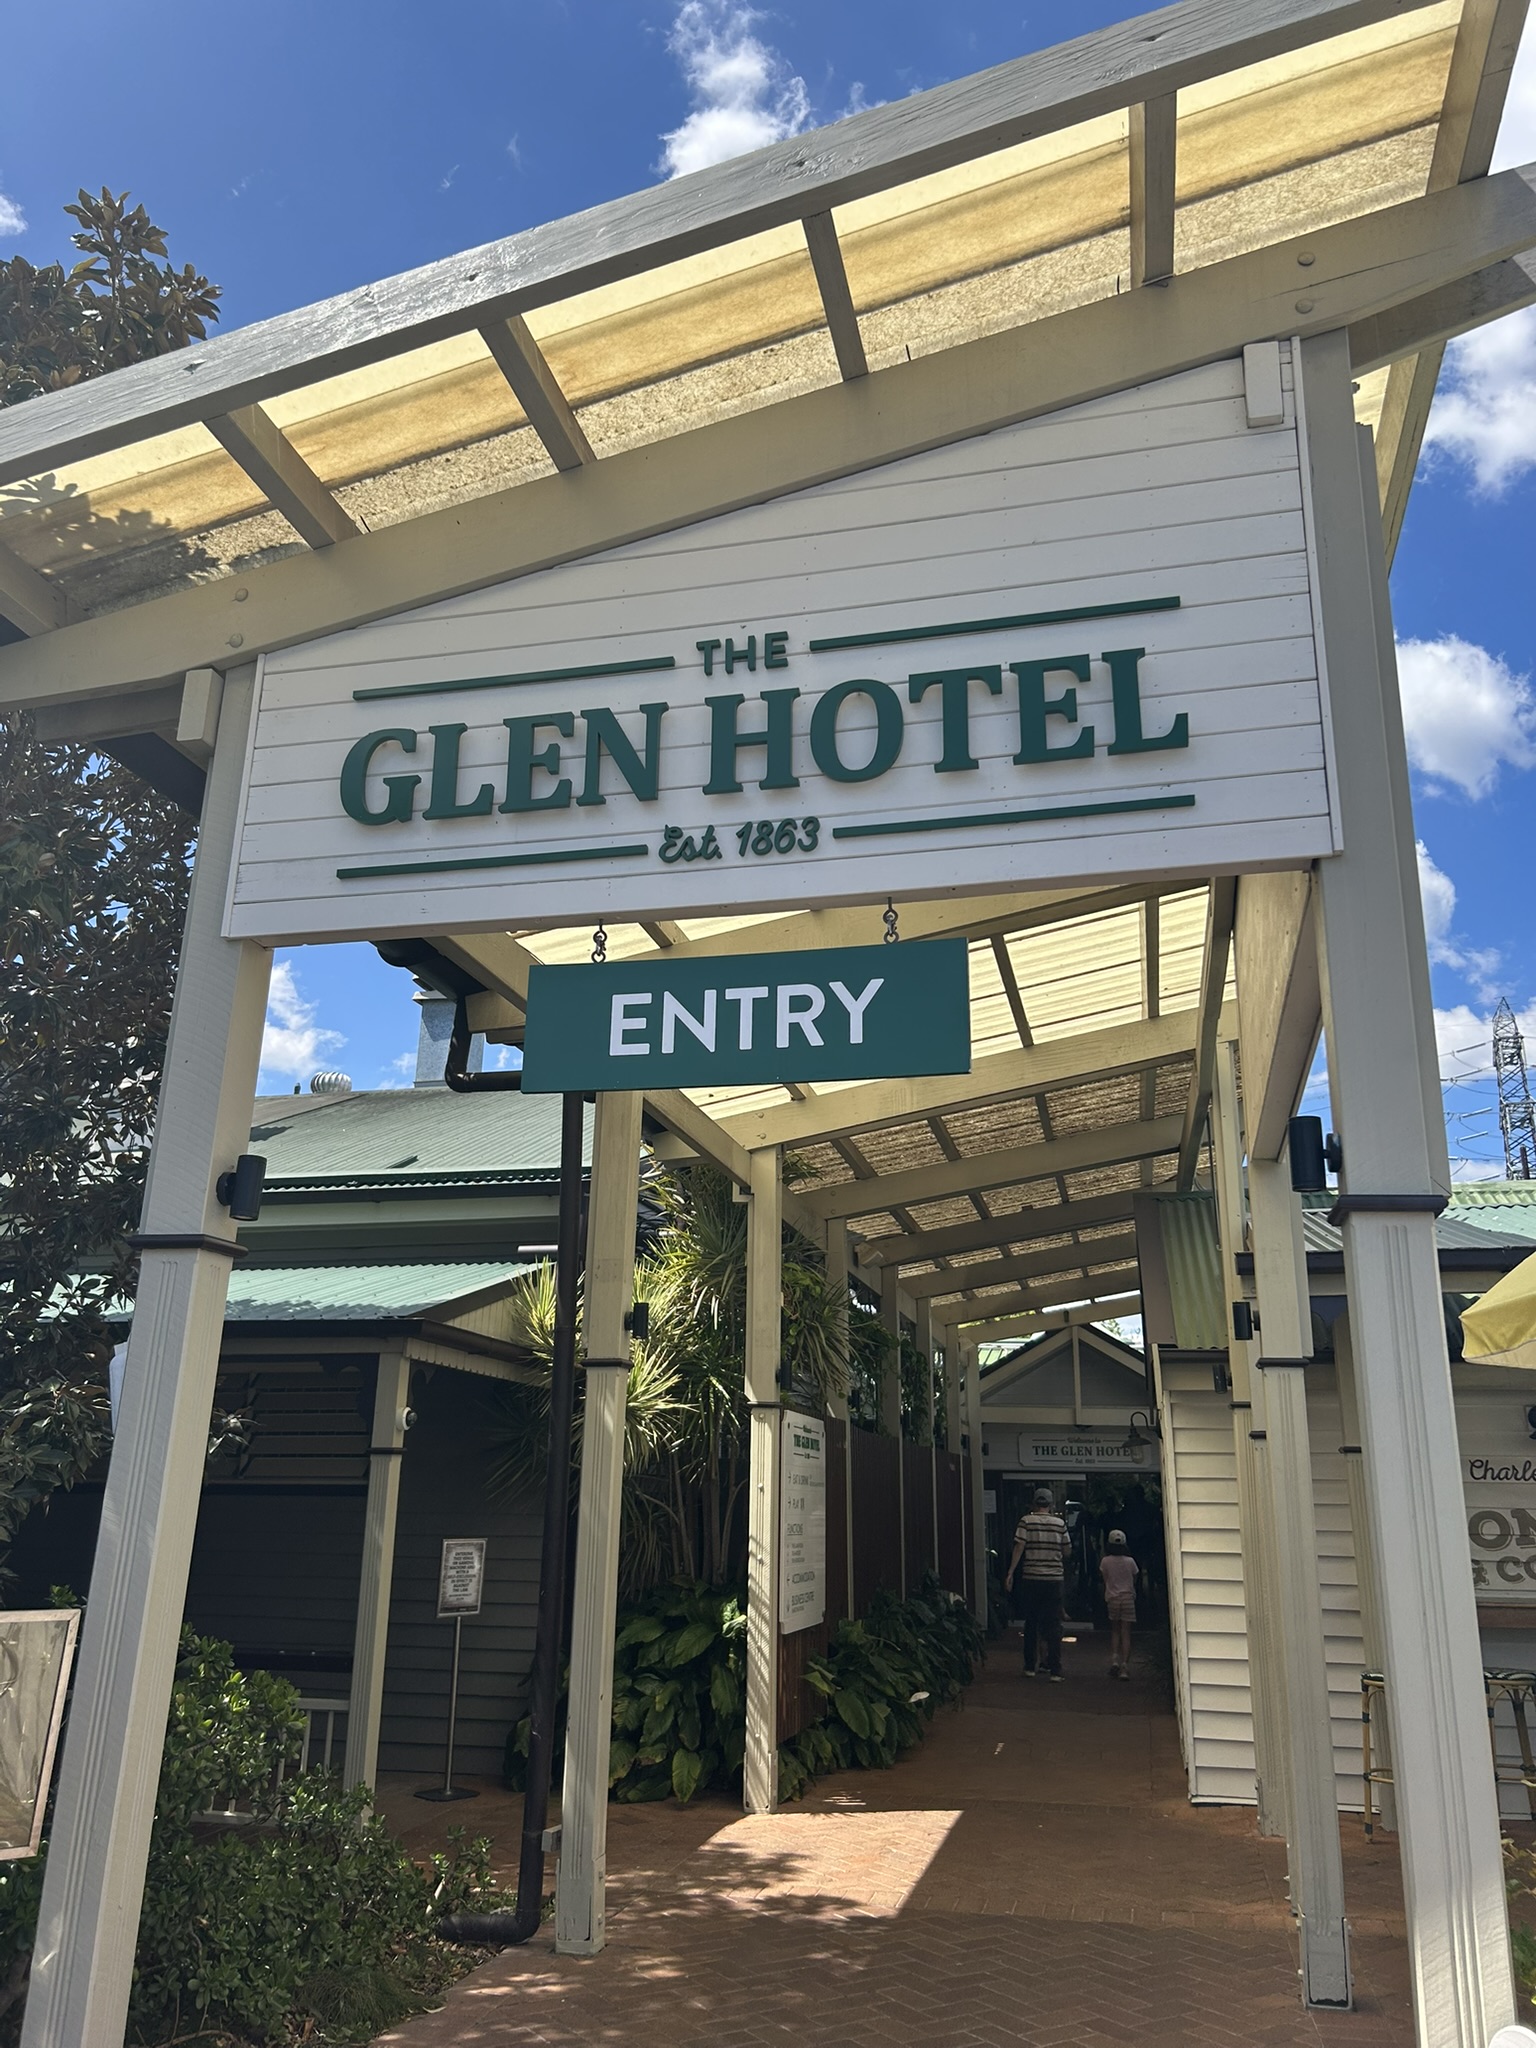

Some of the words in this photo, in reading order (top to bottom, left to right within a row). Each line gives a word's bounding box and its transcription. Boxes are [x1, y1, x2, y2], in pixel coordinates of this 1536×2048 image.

[695, 631, 789, 676] THE
[340, 702, 669, 826] GLEN
[703, 647, 1189, 795] HOTEL
[658, 824, 723, 864] Est.
[735, 816, 821, 857] 1863
[608, 978, 885, 1057] ENTRY
[1032, 1446, 1058, 1456] THE
[1061, 1446, 1092, 1456] GLEN
[1096, 1446, 1131, 1457] HOTE
